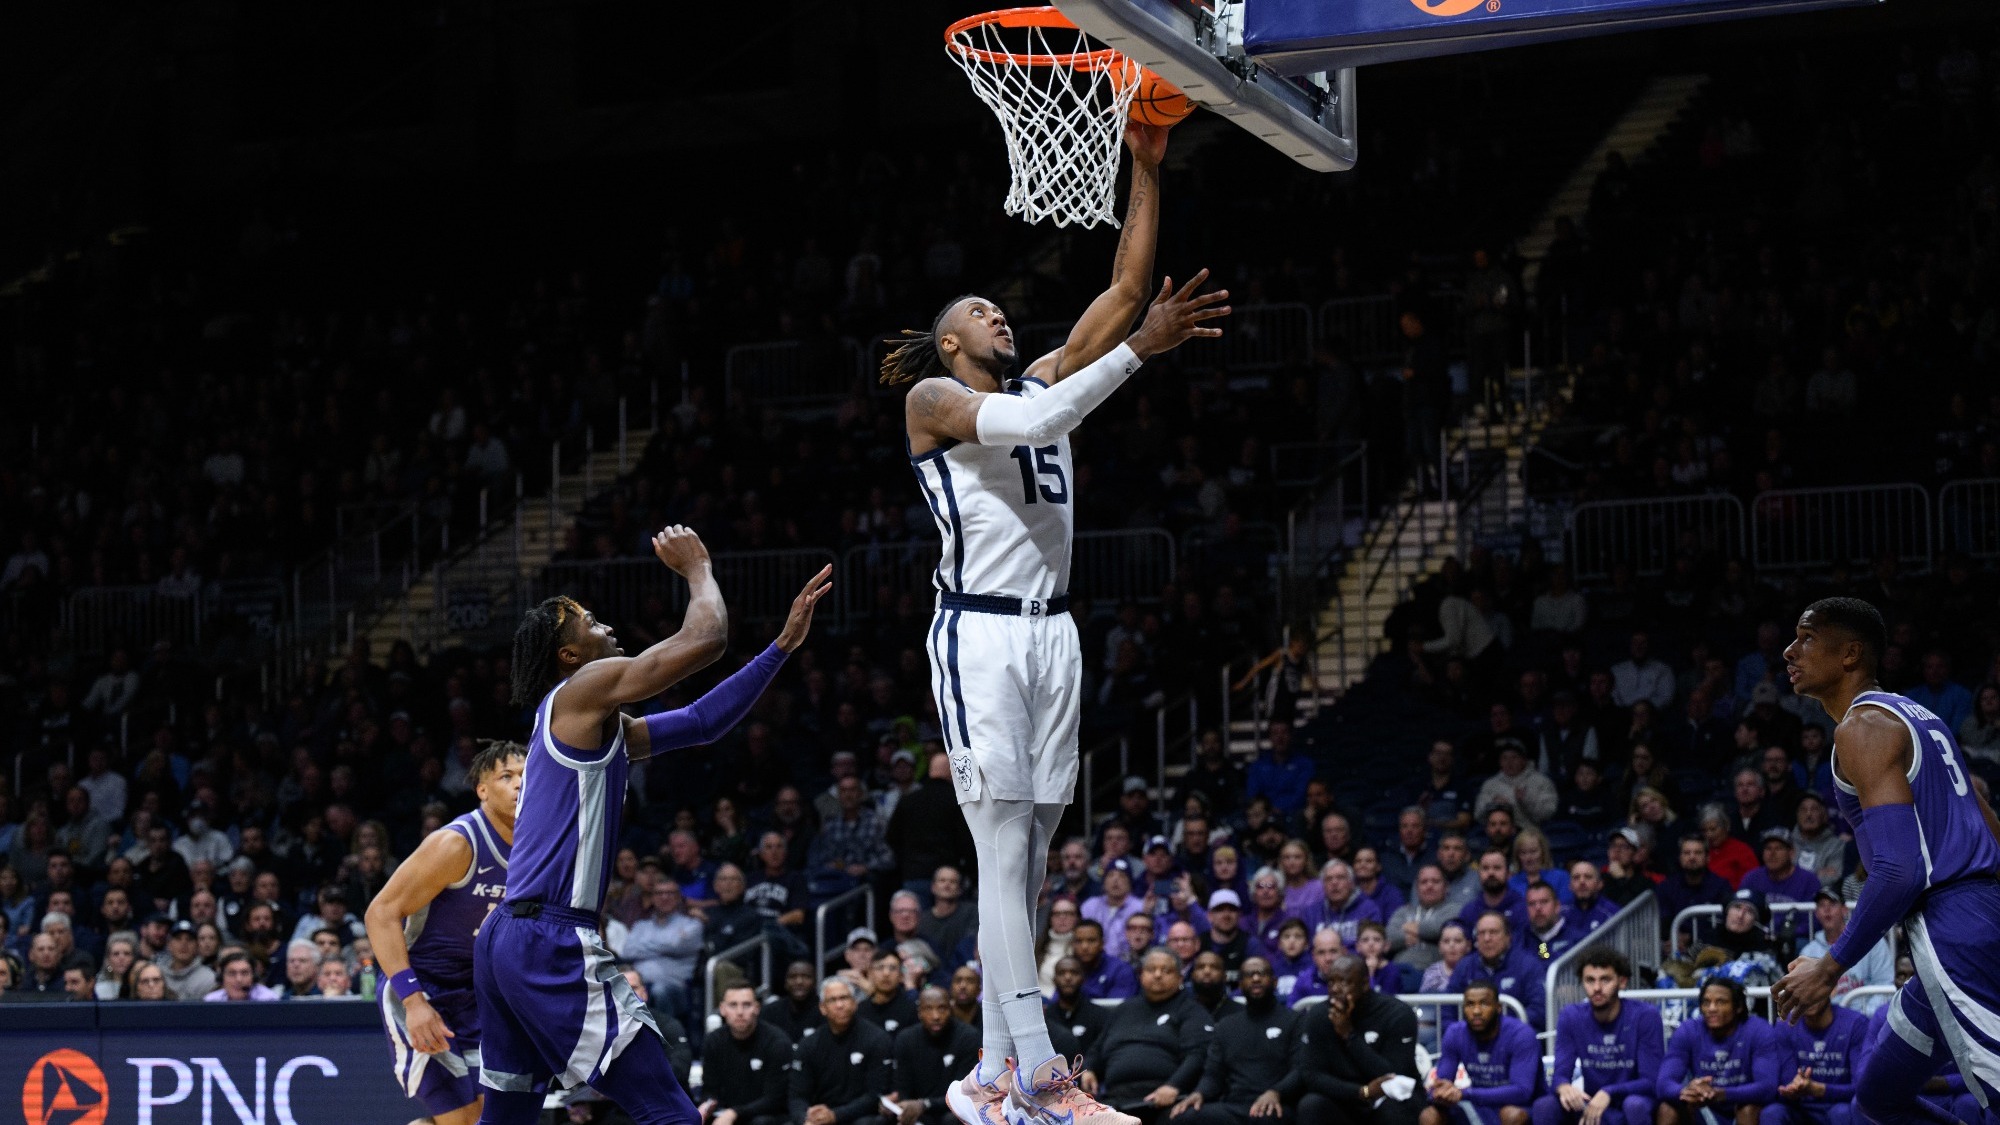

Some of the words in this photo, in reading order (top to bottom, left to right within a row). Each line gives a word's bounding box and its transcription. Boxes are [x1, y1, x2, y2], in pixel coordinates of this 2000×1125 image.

[1010, 444, 1068, 504] 15
[1030, 600, 1041, 616] B
[1927, 729, 1968, 797] 3
[126, 1056, 340, 1125] PNC
